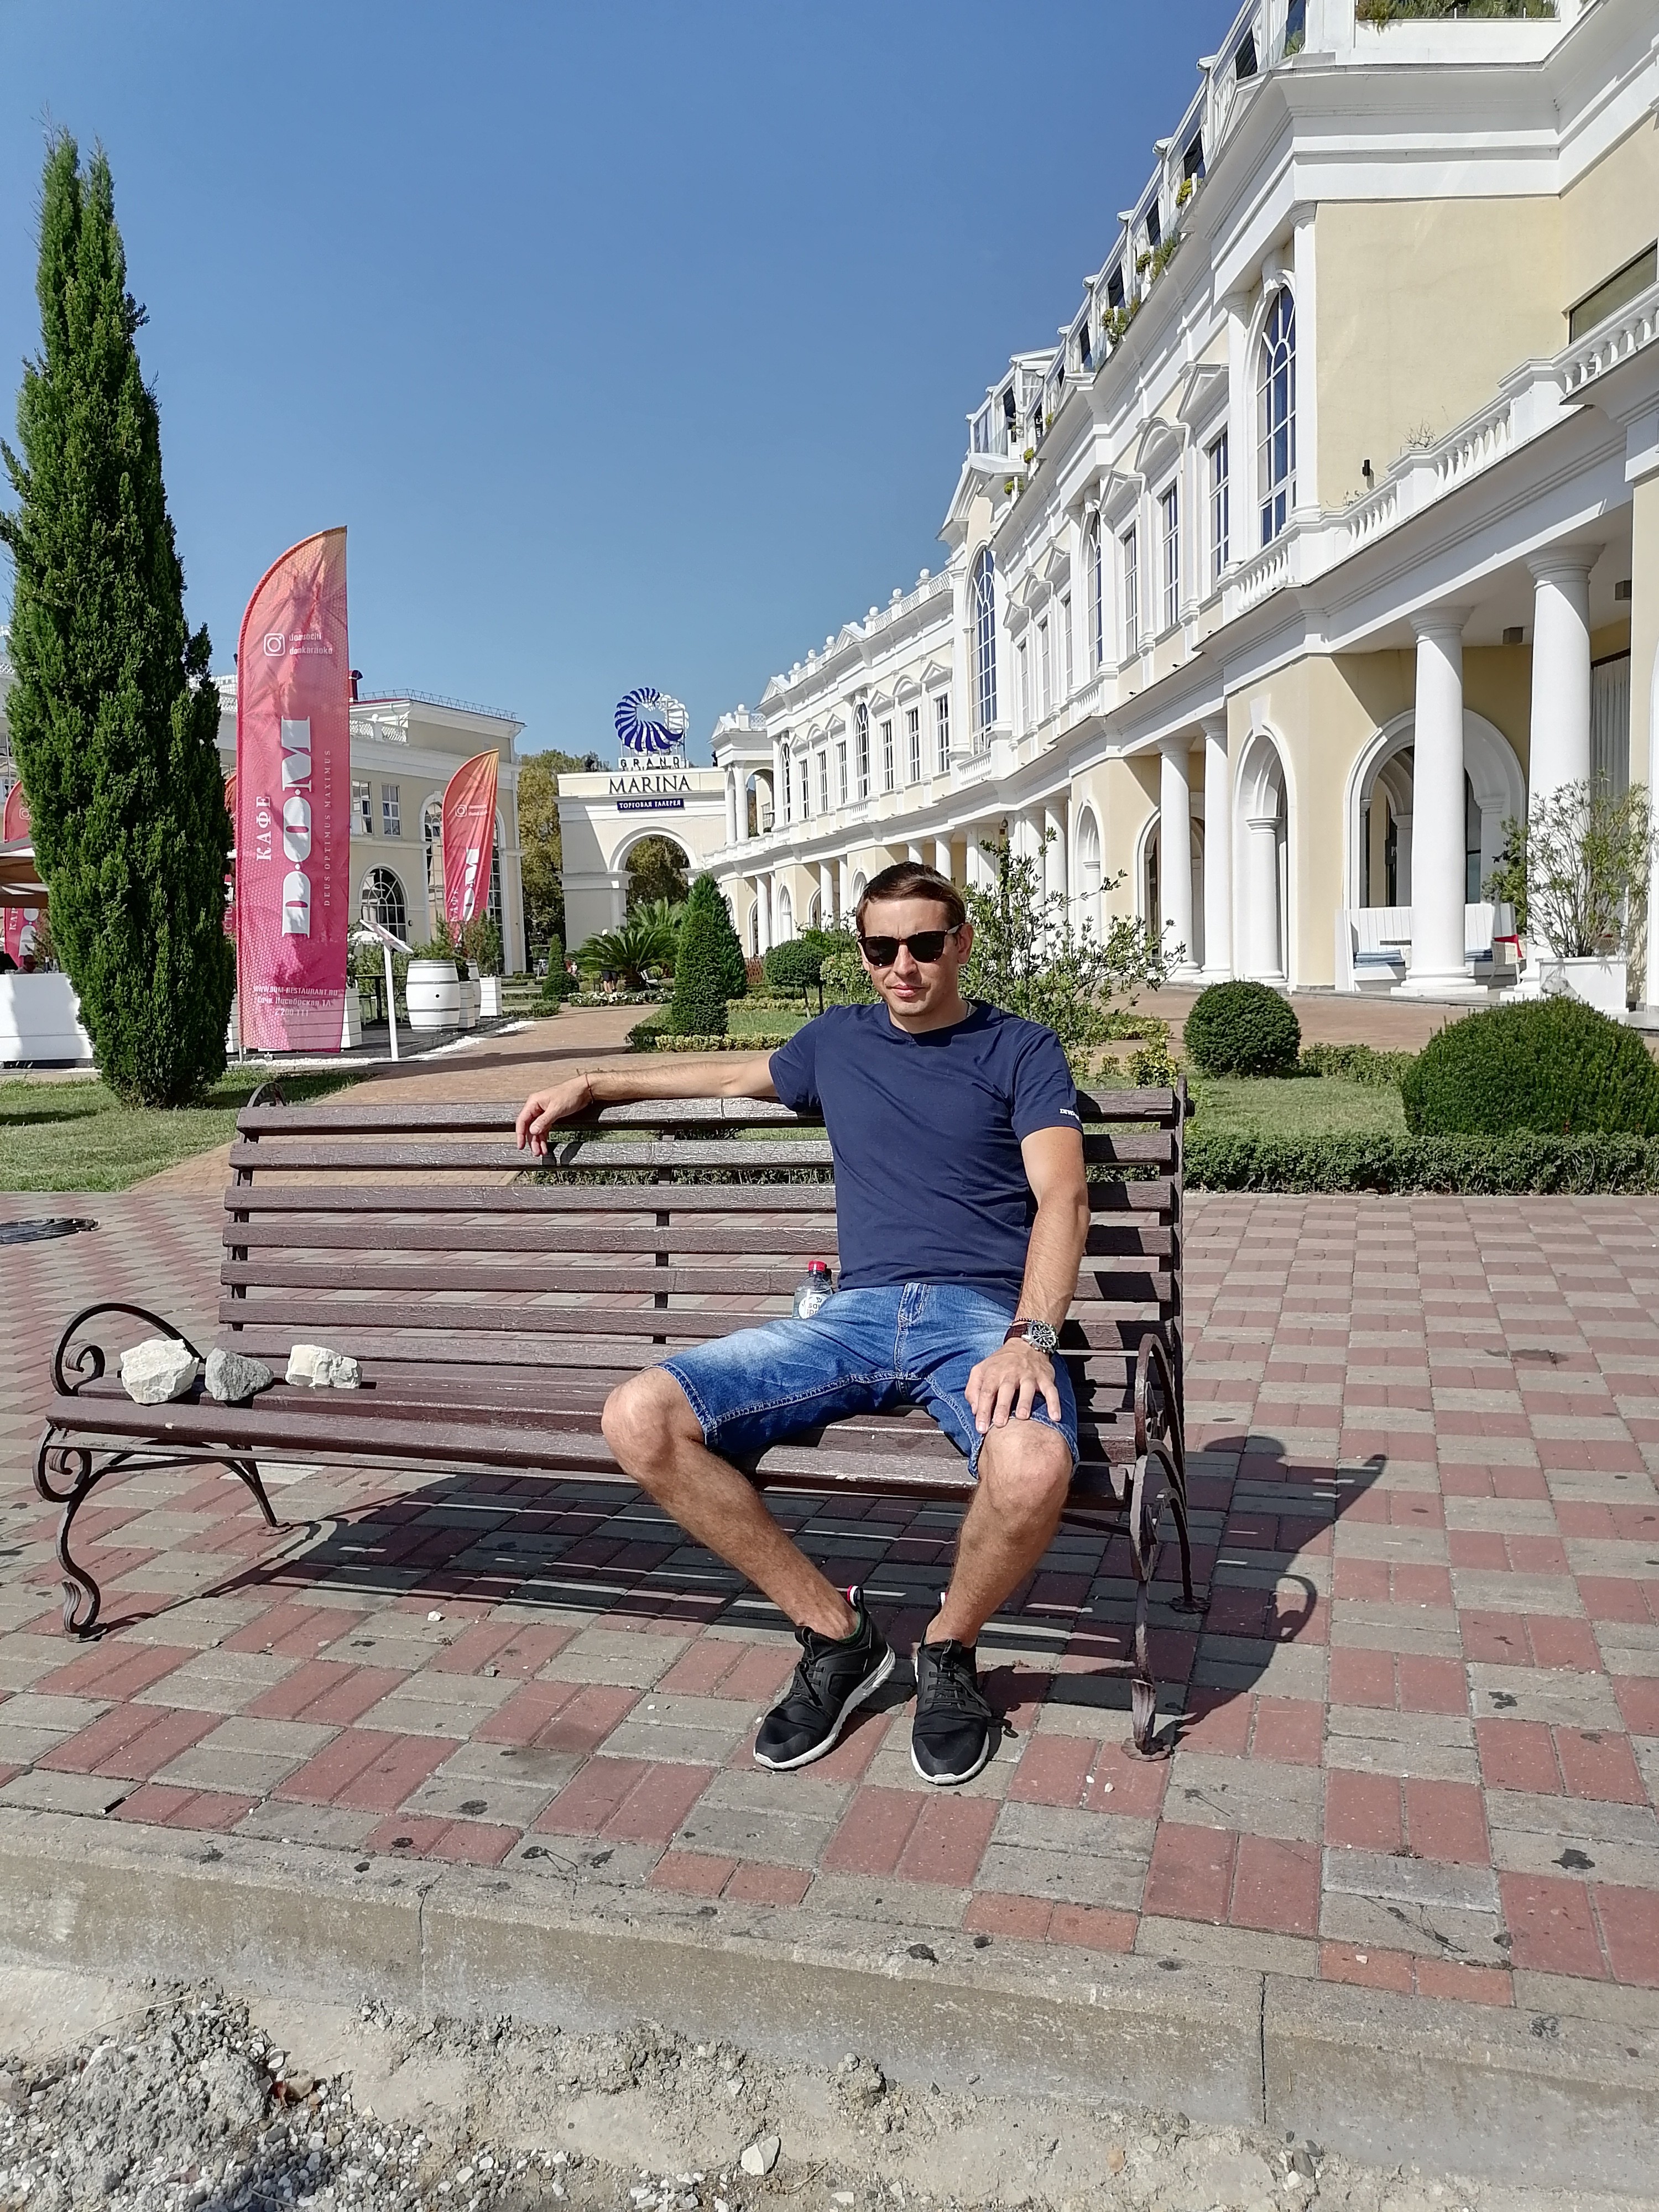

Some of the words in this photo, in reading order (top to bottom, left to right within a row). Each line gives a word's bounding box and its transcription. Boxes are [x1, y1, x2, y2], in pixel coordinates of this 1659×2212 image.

[620, 756, 680, 770] GRAND
[609, 775, 691, 795] MARINA
[256, 796, 272, 862] КАФЕ
